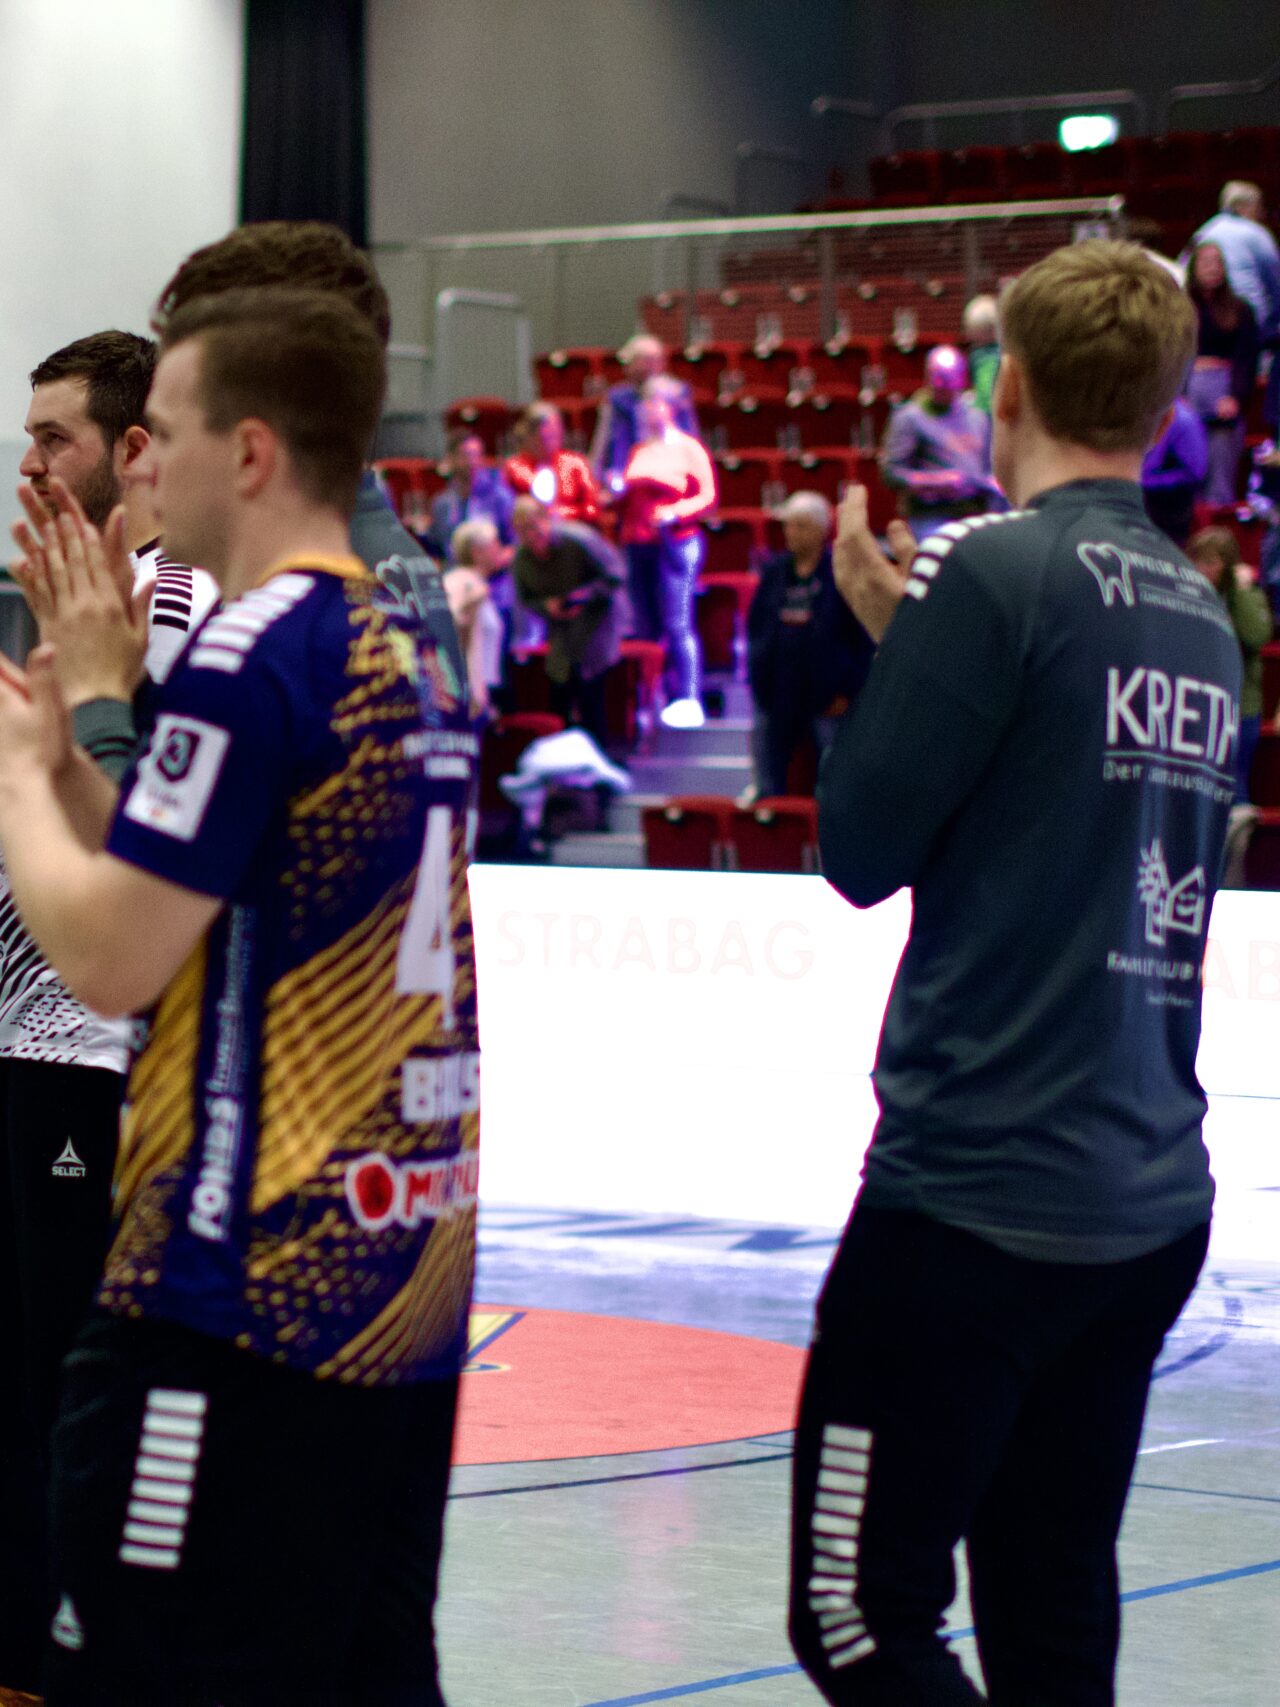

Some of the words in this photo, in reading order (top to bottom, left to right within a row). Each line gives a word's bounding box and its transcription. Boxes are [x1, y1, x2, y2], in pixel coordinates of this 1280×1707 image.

[396, 805, 454, 1030] 4
[496, 910, 815, 981] STRABAG
[51, 1166, 86, 1177] SELECT
